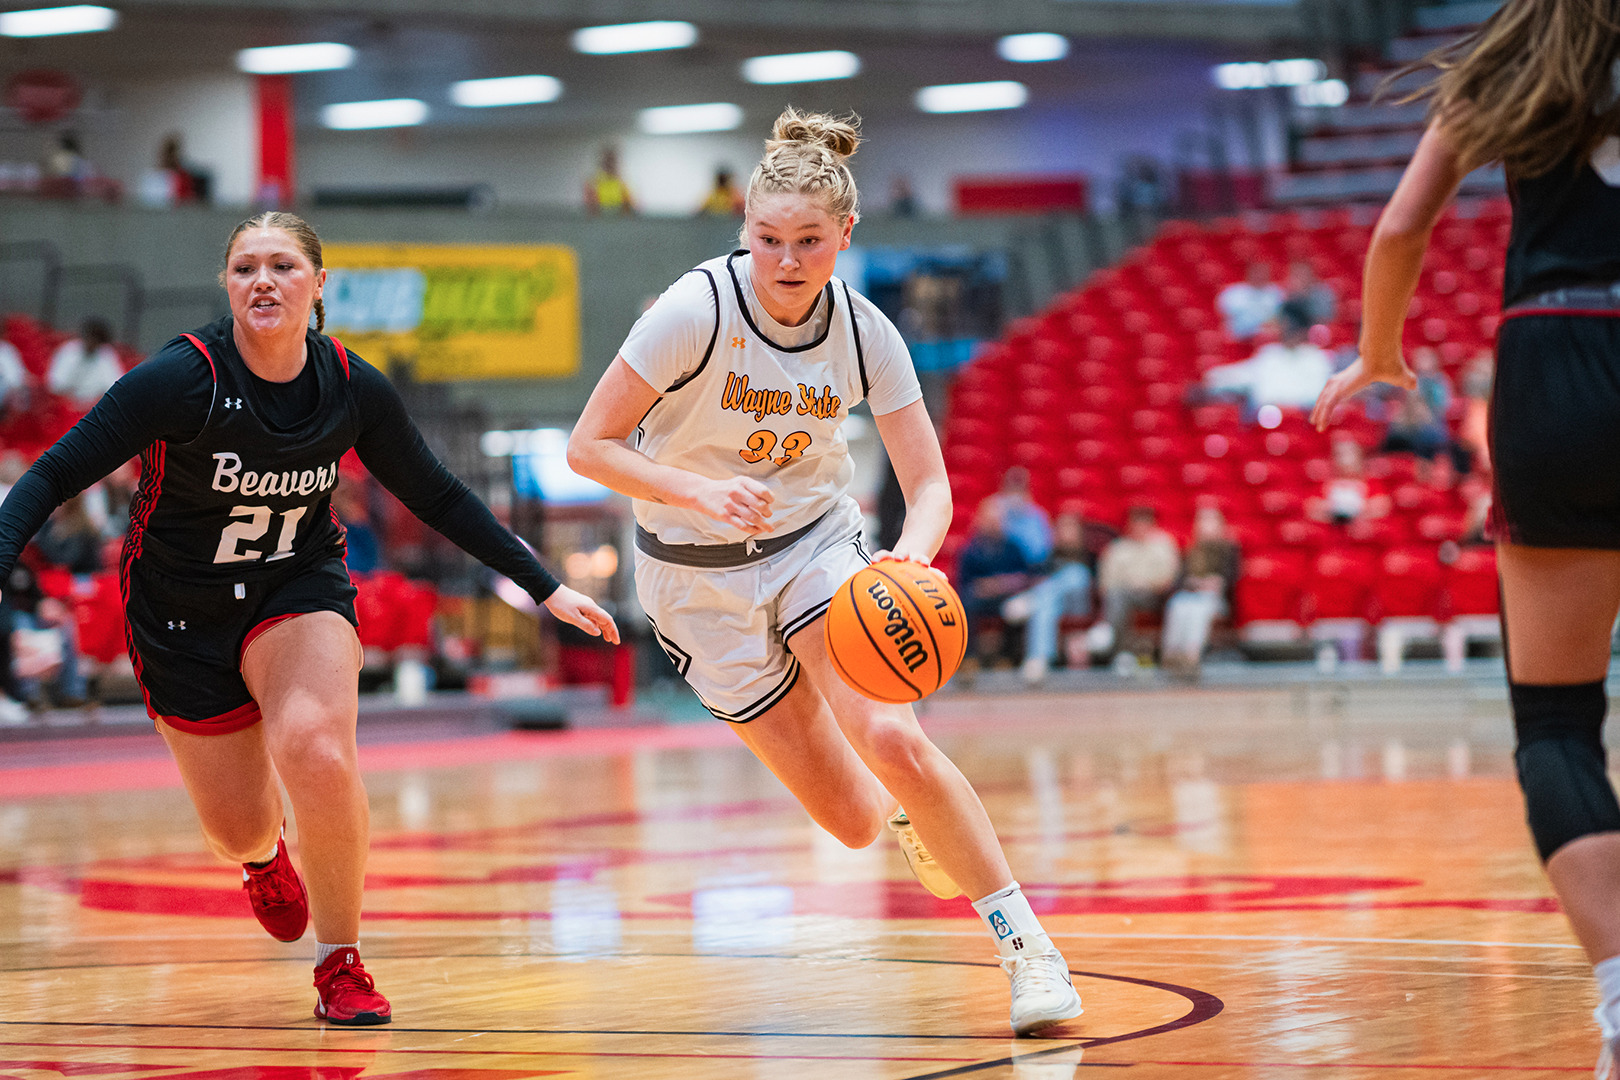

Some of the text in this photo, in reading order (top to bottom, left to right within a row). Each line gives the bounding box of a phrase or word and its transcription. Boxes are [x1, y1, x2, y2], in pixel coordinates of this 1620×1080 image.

[721, 371, 792, 422] Wayne
[211, 452, 337, 497] Beavers
[213, 505, 308, 563] 21
[868, 580, 928, 673] Wilson
